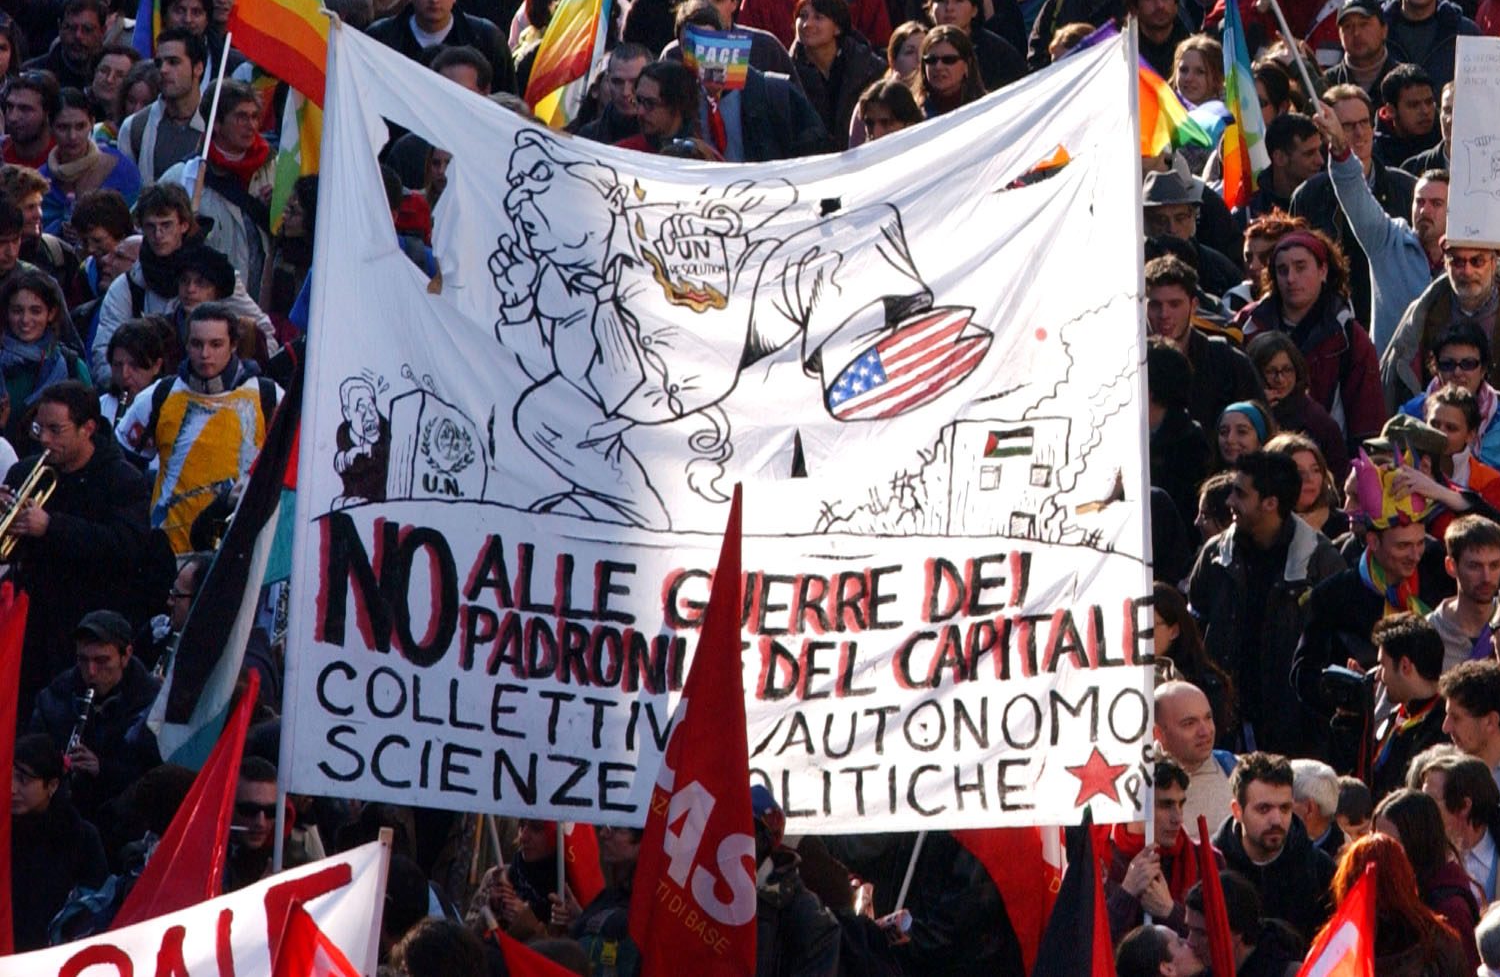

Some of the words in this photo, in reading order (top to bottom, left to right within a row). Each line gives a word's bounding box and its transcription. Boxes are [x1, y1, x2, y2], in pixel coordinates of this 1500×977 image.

[694, 43, 741, 65] PACE
[669, 262, 725, 276] RESOLUTION
[677, 239, 710, 261] UN
[422, 472, 465, 497] U.N.
[314, 511, 458, 667] NO
[463, 533, 637, 623] ALLE
[660, 565, 904, 636] GERRE
[923, 549, 1032, 623] DEI
[458, 603, 687, 695] PADRONI
[755, 636, 877, 701] DEL
[892, 595, 1156, 690] CAPITALE
[316, 660, 678, 753] COLLETTIV
[317, 724, 639, 813] SCIENZE
[684, 908, 731, 956] BASE
